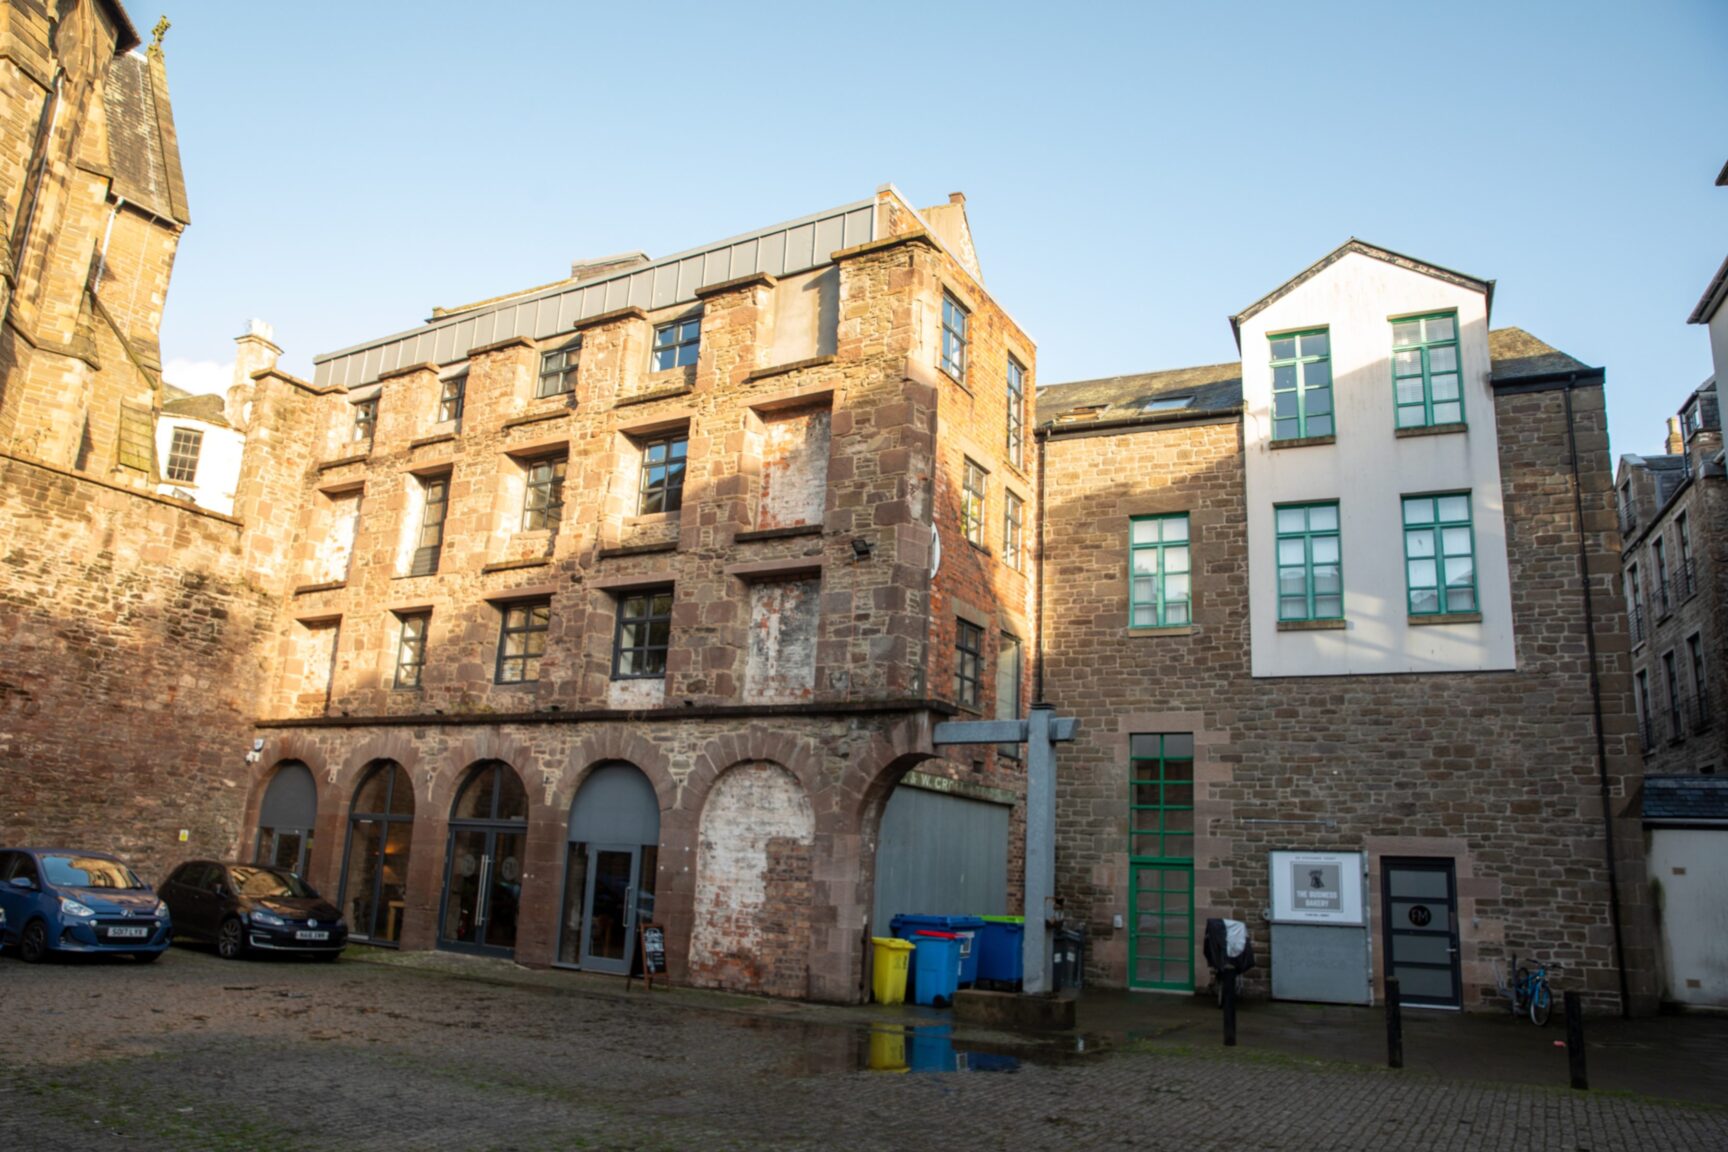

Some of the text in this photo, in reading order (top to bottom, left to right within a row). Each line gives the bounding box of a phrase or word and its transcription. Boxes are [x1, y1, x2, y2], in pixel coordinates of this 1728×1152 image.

[1296, 890, 1338, 899] THE BUSINESS
[1305, 899, 1329, 907] BAKERY
